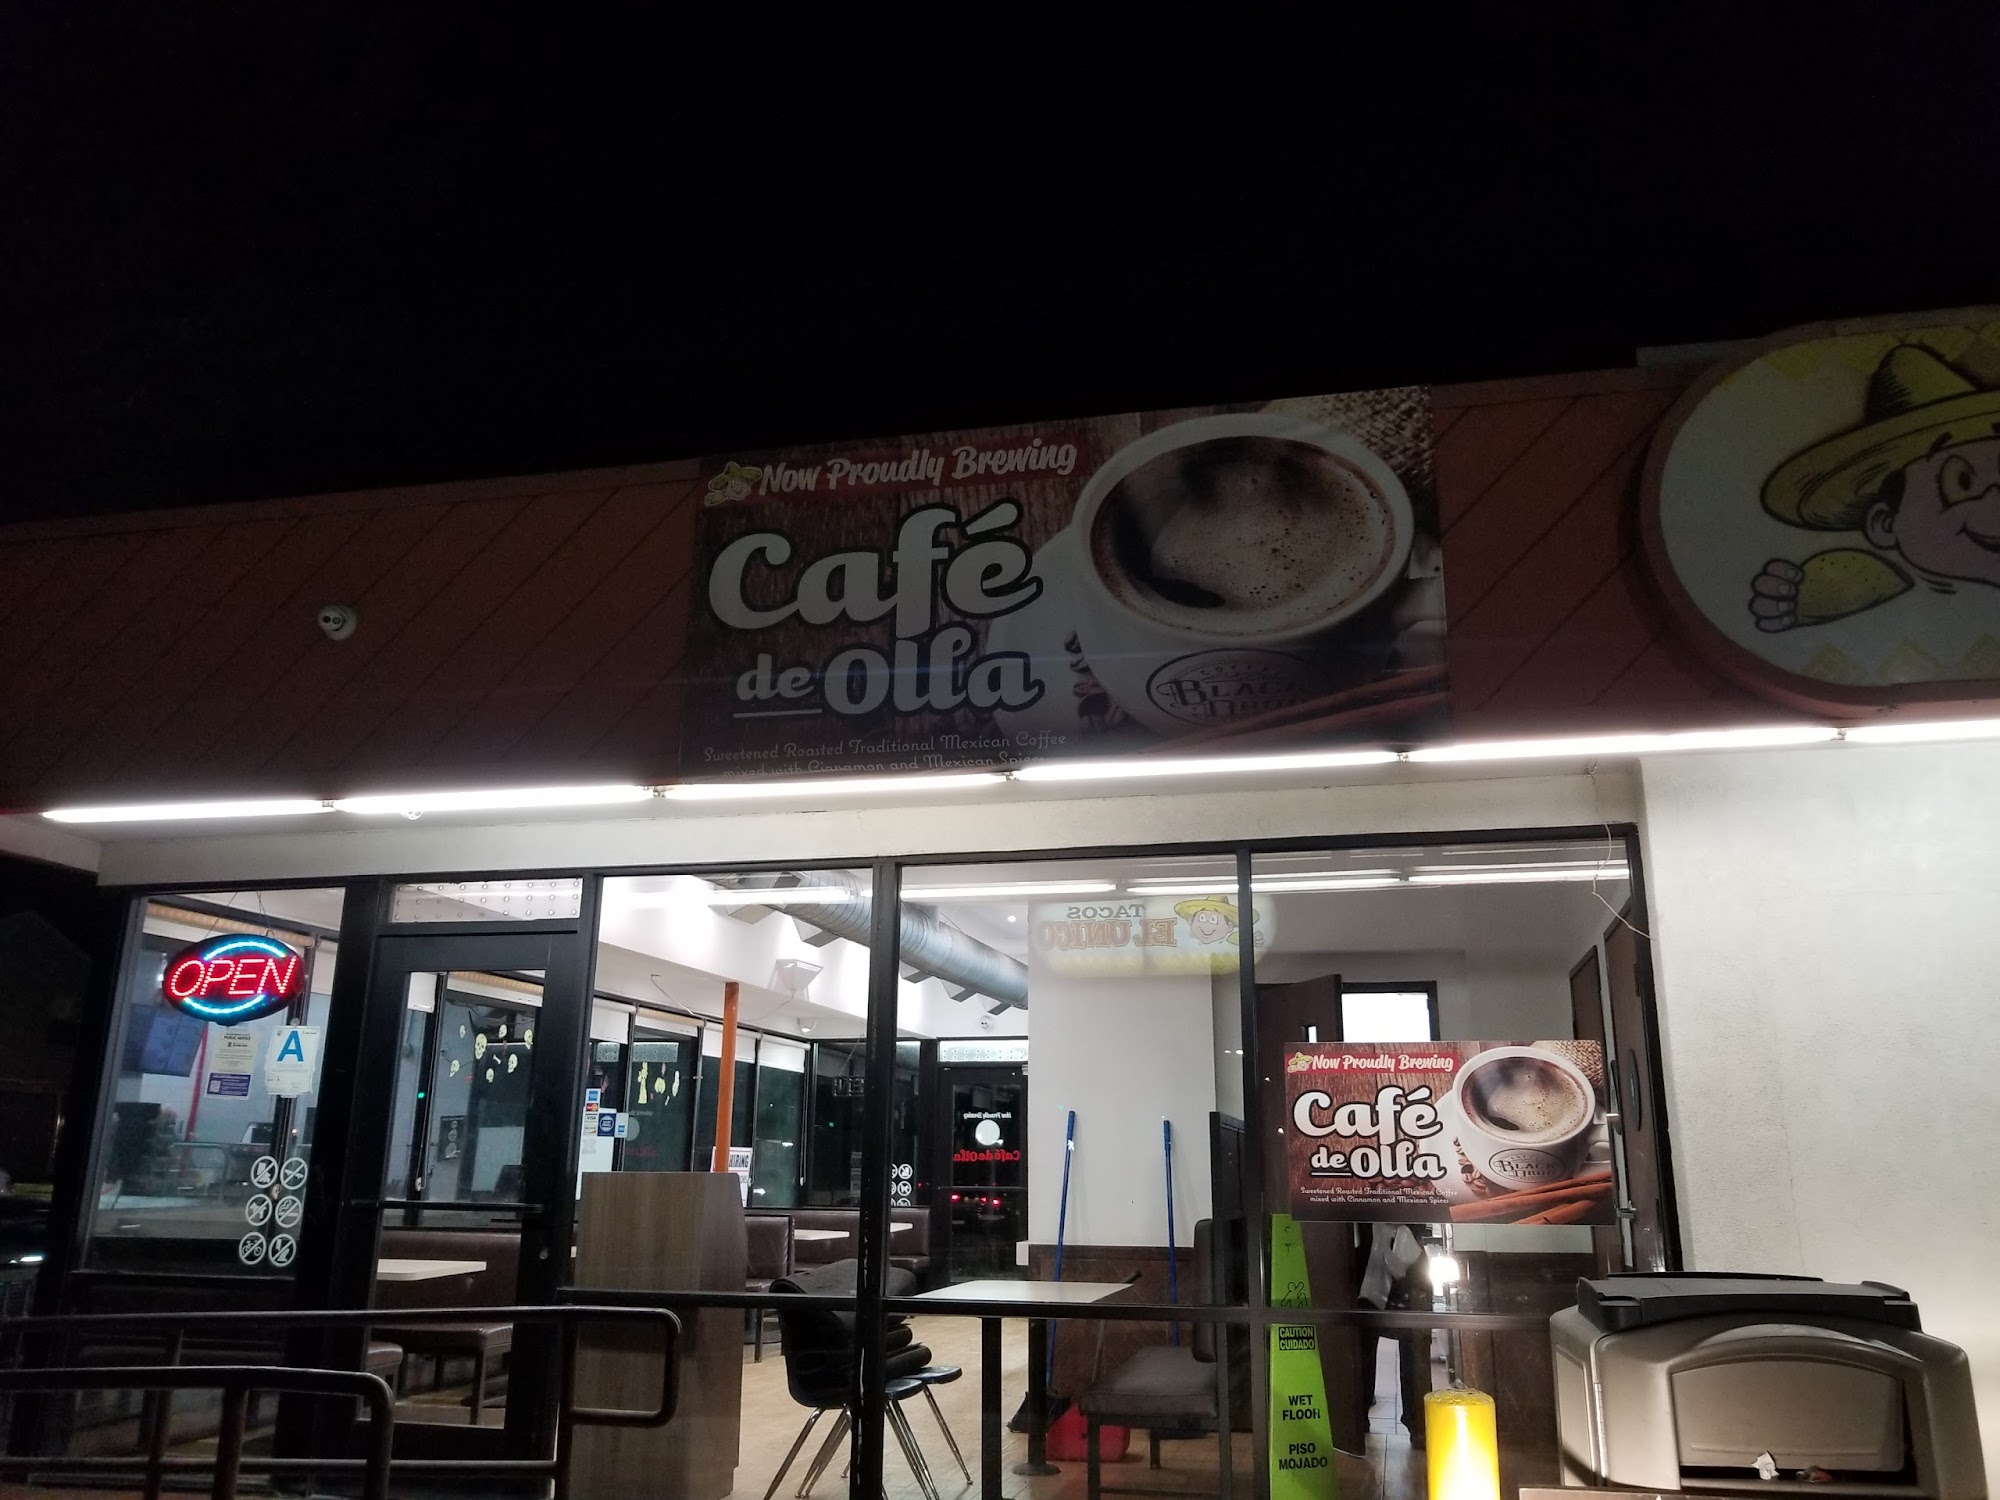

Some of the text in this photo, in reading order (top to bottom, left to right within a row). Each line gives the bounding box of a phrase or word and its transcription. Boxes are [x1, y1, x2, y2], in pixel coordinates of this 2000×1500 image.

[758, 437, 1078, 496] Now Proudly Brewing
[707, 500, 1044, 640] Café
[735, 625, 1043, 716] de Olla
[704, 730, 1067, 762] Sweetened Roasted Traditional Mexican Coffee
[723, 761, 766, 777] mixed
[771, 760, 802, 776] with
[807, 758, 885, 774] Cinnamon
[889, 756, 919, 771] and
[922, 753, 994, 769] Mexican
[170, 955, 298, 997] OPEN
[276, 1030, 304, 1062] A
[1311, 1053, 1454, 1072] Now Proudly Brewing
[1293, 1086, 1443, 1145] Café
[1311, 1140, 1447, 1178] de Olla
[1300, 1186, 1459, 1197] Sweetened Roasted Traditional Mexican Coffee
[1309, 1195, 1450, 1205] mixed with Cinnamon and Mexican Spices
[1279, 1326, 1315, 1339] CAUTION
[1279, 1338, 1316, 1351] CUIDADO
[1288, 1394, 1314, 1407] WET
[1282, 1408, 1321, 1421] FLOOR
[1288, 1442, 1317, 1455] PISO
[1278, 1456, 1328, 1471] MOJADO
